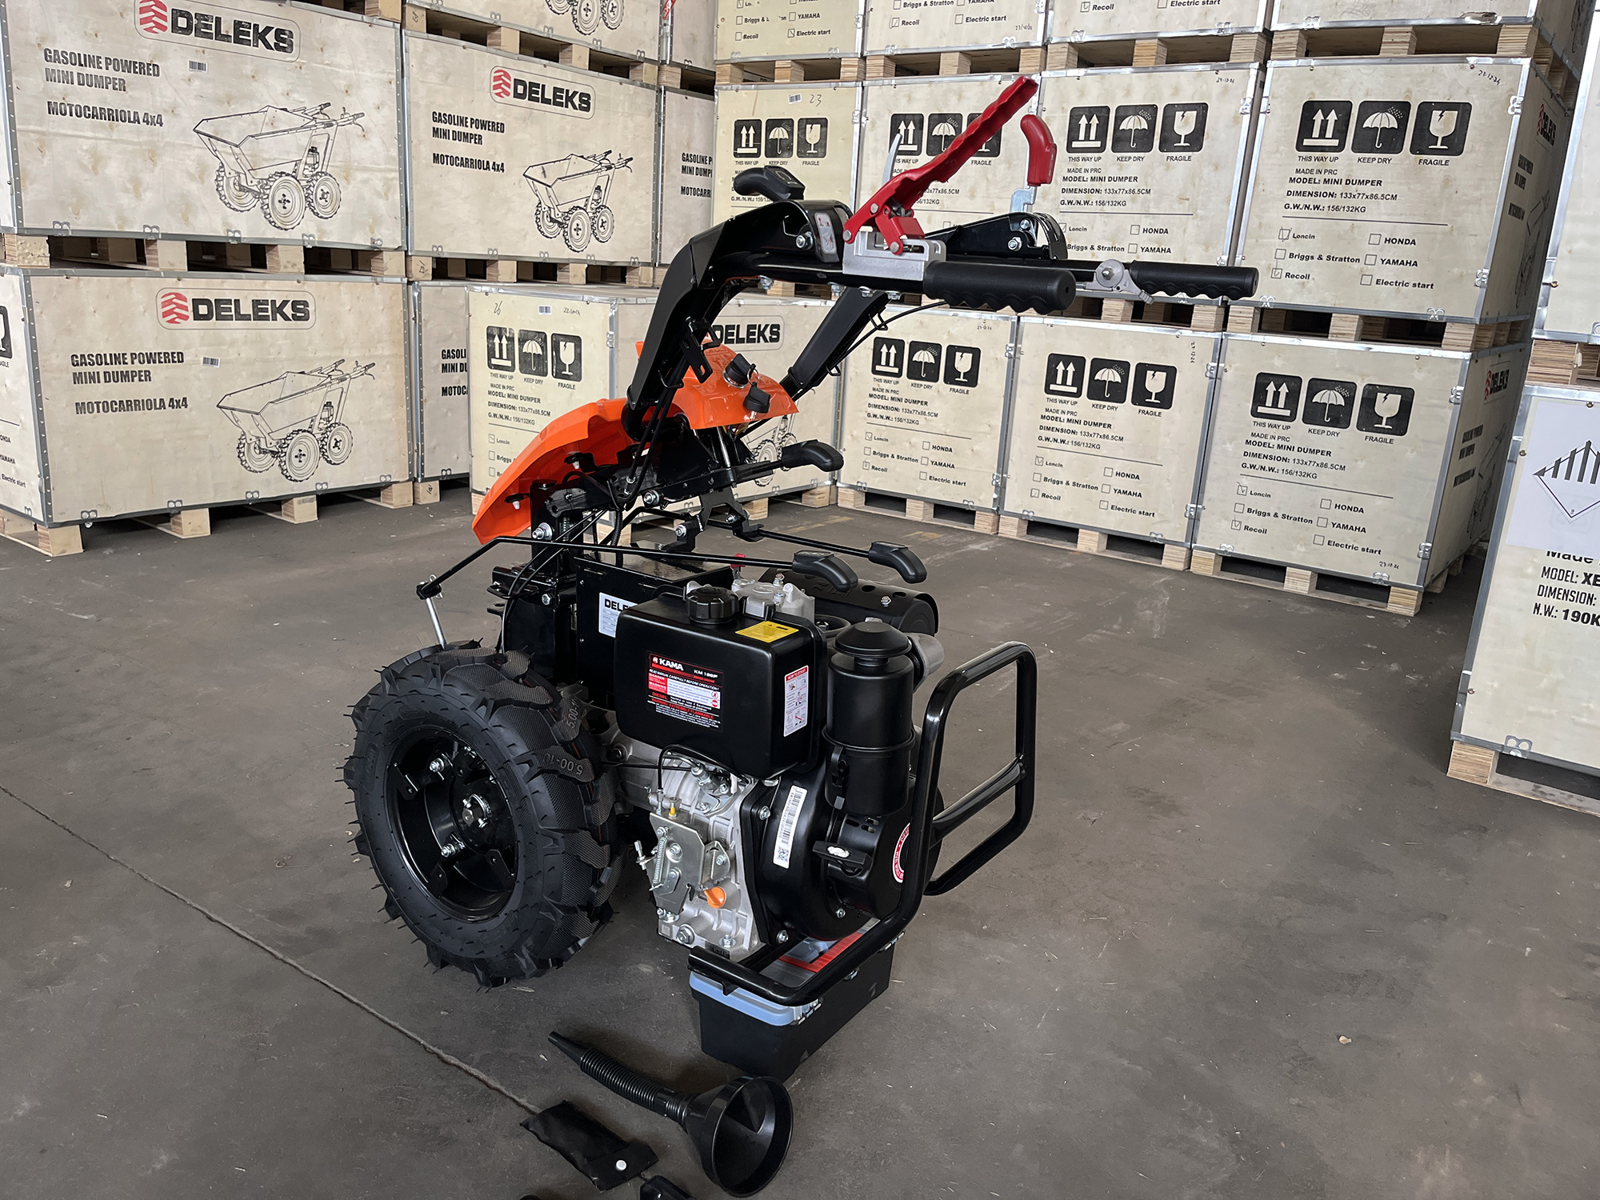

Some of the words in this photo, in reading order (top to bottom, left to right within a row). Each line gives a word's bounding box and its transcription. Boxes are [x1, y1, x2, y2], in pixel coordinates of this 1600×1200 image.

[903, 1, 921, 9] Briggs
[171, 8, 294, 54] DELEKS
[44, 48, 102, 69] GASOLINE
[105, 56, 160, 77] POWERED
[45, 68, 74, 86] MINI
[77, 73, 126, 92] DUMPER
[513, 78, 591, 112] DELEKS
[809, 94, 822, 107] 23
[47, 101, 140, 125] MOTOCARRIOLA
[143, 113, 163, 127] 4x4
[432, 111, 468, 128] GASOLINE
[470, 117, 505, 133] POWERED
[432, 127, 450, 141] MINI
[452, 130, 483, 145] DUMPER
[432, 153, 490, 172] MOTOCARRIOLA
[492, 162, 505, 173] 4x4
[682, 153, 708, 164] GASOLINE
[682, 165, 694, 175] MINI
[696, 167, 712, 178] DUMP
[1289, 177, 1320, 185] MODEL:
[1345, 179, 1383, 187] DUMPER
[681, 186, 711, 198] MOTOCARR
[1286, 190, 1337, 198] DIMENSION:
[1340, 192, 1397, 201] 133x77x86.5CM
[1284, 203, 1325, 211] G.W./N.W.:
[1327, 205, 1366, 213] 156/132KG
[1384, 237, 1416, 246] HONDA
[1289, 253, 1314, 262] Briggs
[1326, 254, 1360, 263] Stratton
[1380, 258, 1418, 267] YAMAHA
[1285, 272, 1310, 280] Recoil
[1375, 279, 1409, 288] Electric
[1412, 281, 1434, 290] start
[192, 298, 310, 321] DELEKS
[714, 324, 780, 345] DELEKS
[71, 352, 128, 367] GASOLINE
[131, 351, 184, 365] POWERED
[442, 349, 466, 359] GASOLI
[442, 363, 458, 373] MINI
[72, 371, 100, 385] MINI
[104, 370, 152, 383] DUMPER
[488, 390, 506, 398] MODEL:
[520, 395, 541, 403] DUMPER
[869, 393, 889, 401] MODEL:
[890, 395, 903, 403] MINI
[904, 398, 928, 406] DUMPER
[75, 398, 166, 414] MOTOCARRIOLA
[168, 397, 188, 410] 4x4
[488, 401, 517, 411] DIMENSION:
[868, 403, 900, 412] DIMENSION:
[1138, 409, 1162, 417] FRAGILE
[1040, 415, 1065, 423] MODEL:
[1083, 420, 1112, 429] DUMPER
[1253, 421, 1266, 429] THIS
[0, 435, 11, 443] ONDA
[1039, 425, 1078, 435] DIMENSION:
[1080, 431, 1123, 442] 133x77x86.5CM
[1251, 432, 1268, 440] MADE
[1365, 435, 1394, 445] FRAGILE
[1071, 440, 1100, 449] 156/132KG
[1245, 440, 1274, 449] MODEL:
[1277, 444, 1295, 452] MINI
[1297, 446, 1332, 457] DUMPER
[873, 451, 889, 459] Briggs
[1243, 451, 1290, 463] DIMENSION:
[1292, 458, 1346, 472] 133x77x86.5CM
[931, 460, 955, 469] YAMAHA
[1241, 463, 1279, 474] G.W./N.W.:
[1281, 469, 1317, 479] 156/132KG
[929, 475, 950, 484] Electric
[1115, 471, 1140, 480] HONDA
[1044, 477, 1063, 485] Briggs
[1072, 481, 1099, 491] Stratton
[1042, 493, 1061, 501] Recoil
[1113, 488, 1142, 498] YAMAHA
[1111, 505, 1136, 515] Electric
[1138, 509, 1155, 518] start
[1334, 503, 1365, 514] HONDA
[1247, 508, 1271, 518] Briggs
[1281, 513, 1313, 524] Stratton
[1244, 525, 1267, 535] Recoil
[1331, 522, 1366, 533] YAMAHA
[1327, 540, 1359, 552] Electric
[1361, 546, 1381, 555] start
[1541, 566, 1579, 584] MODEL:
[1581, 572, 1600, 587] XE
[1537, 584, 1597, 606] DIMENSION:
[605, 599, 628, 612] DELE
[1533, 603, 1558, 618] N.W.:
[1562, 609, 1600, 626] 190K
[659, 658, 684, 671] KAMA
[566, 699, 579, 728] 5.00-1
